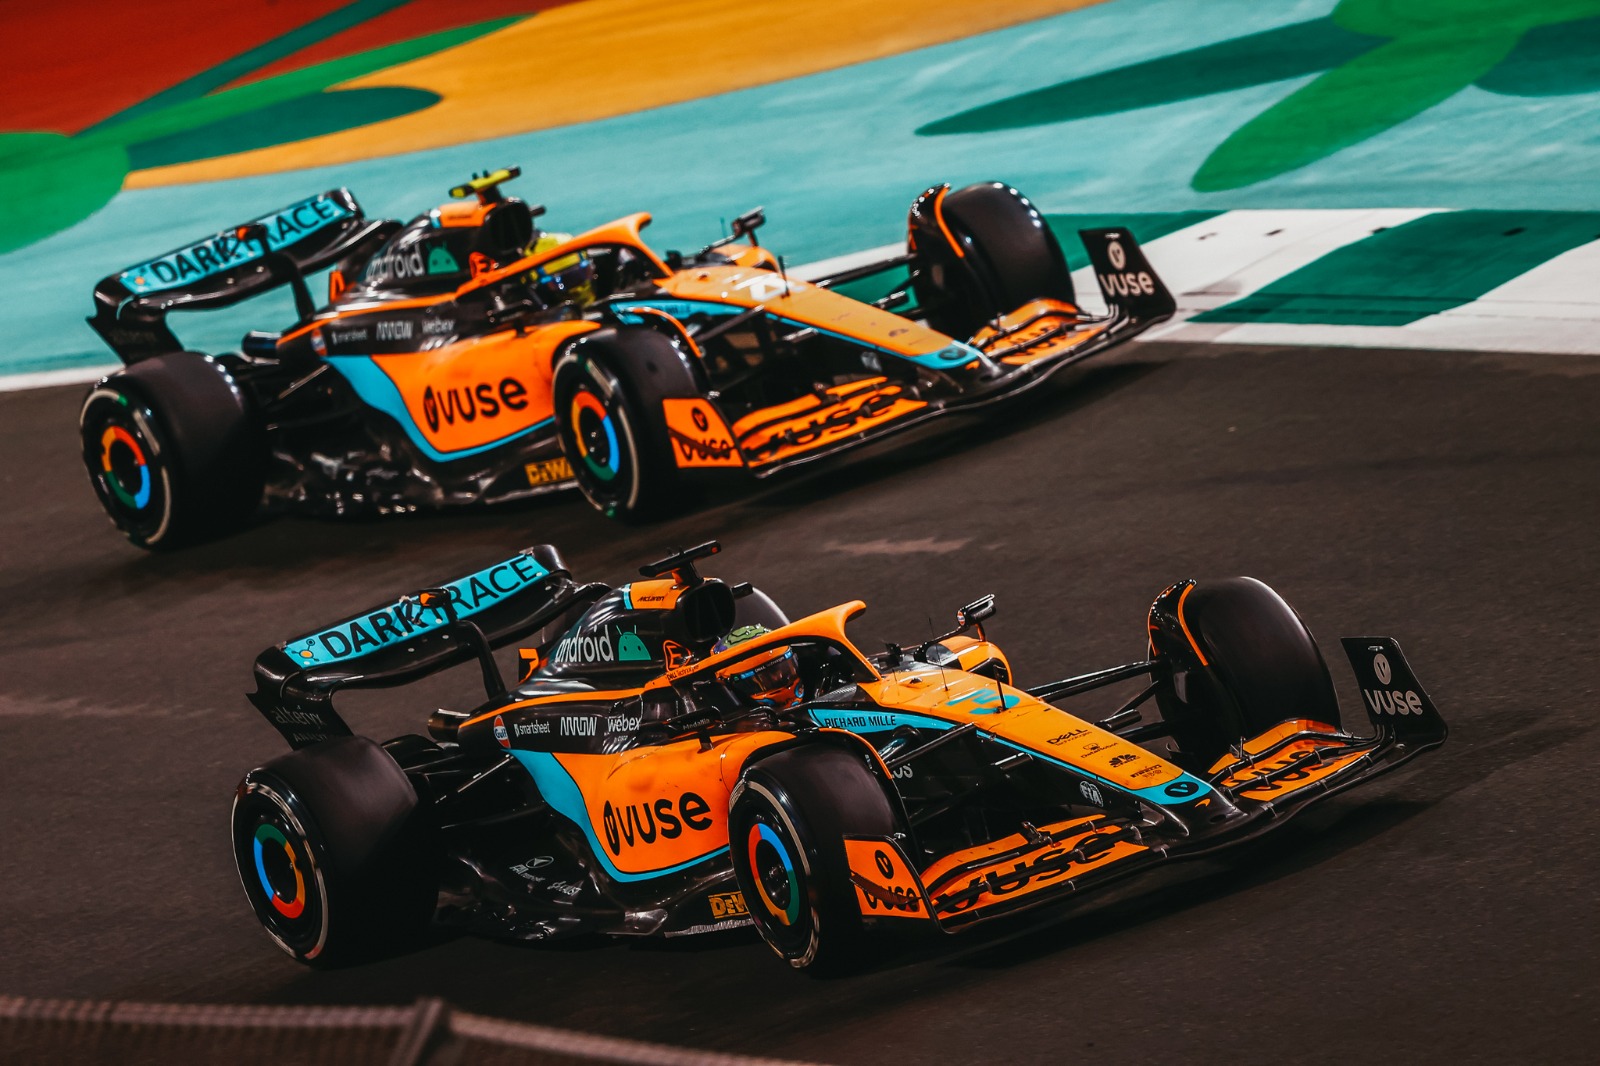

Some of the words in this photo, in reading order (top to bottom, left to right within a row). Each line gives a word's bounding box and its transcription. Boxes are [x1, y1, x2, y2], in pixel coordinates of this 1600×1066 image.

[151, 201, 333, 283] DARKACE
[554, 624, 614, 662] android
[519, 719, 551, 736] smartsheet
[607, 713, 642, 733] webex
[824, 716, 867, 729] RICHARD
[868, 714, 897, 727] MILLE
